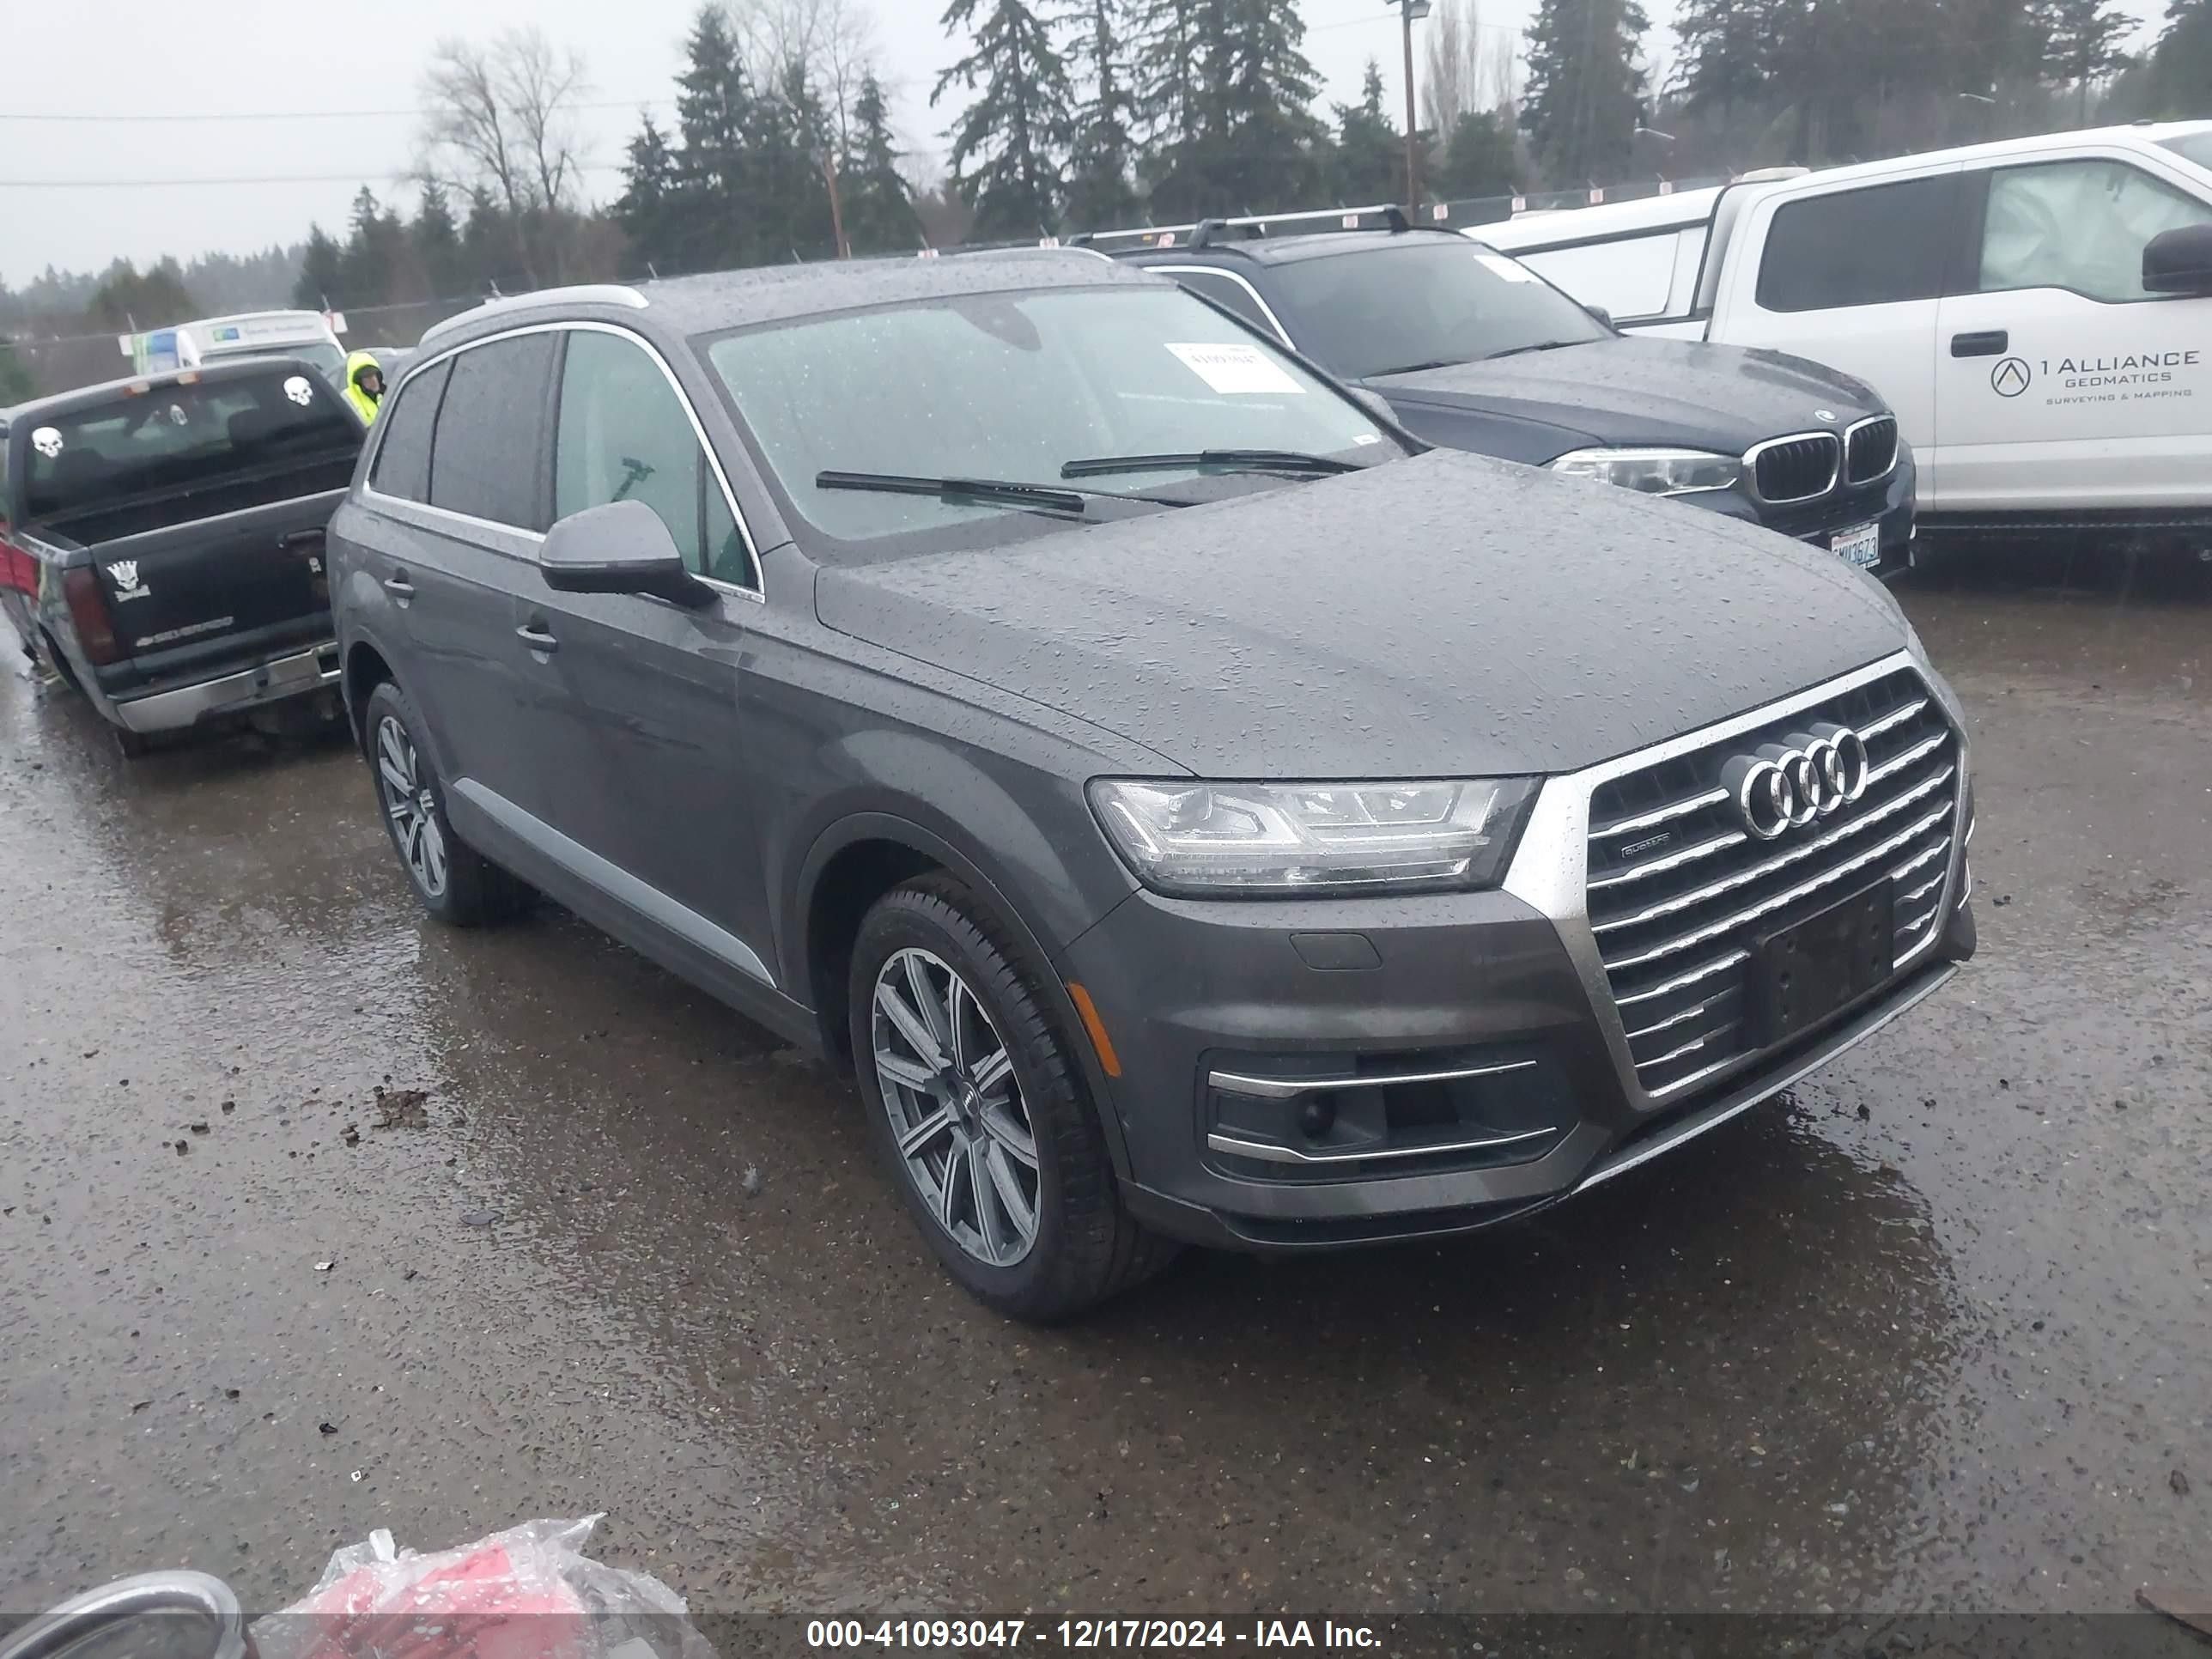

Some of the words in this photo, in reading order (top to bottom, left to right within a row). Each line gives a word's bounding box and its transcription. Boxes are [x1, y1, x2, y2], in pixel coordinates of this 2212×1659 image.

[2040, 361, 2048, 375] 1
[2057, 350, 2200, 374] ALLIANCE
[2065, 371, 2172, 388] GEOMATICS
[2046, 393, 2116, 405] SURVEYING
[2134, 389, 2193, 399] MAPPING
